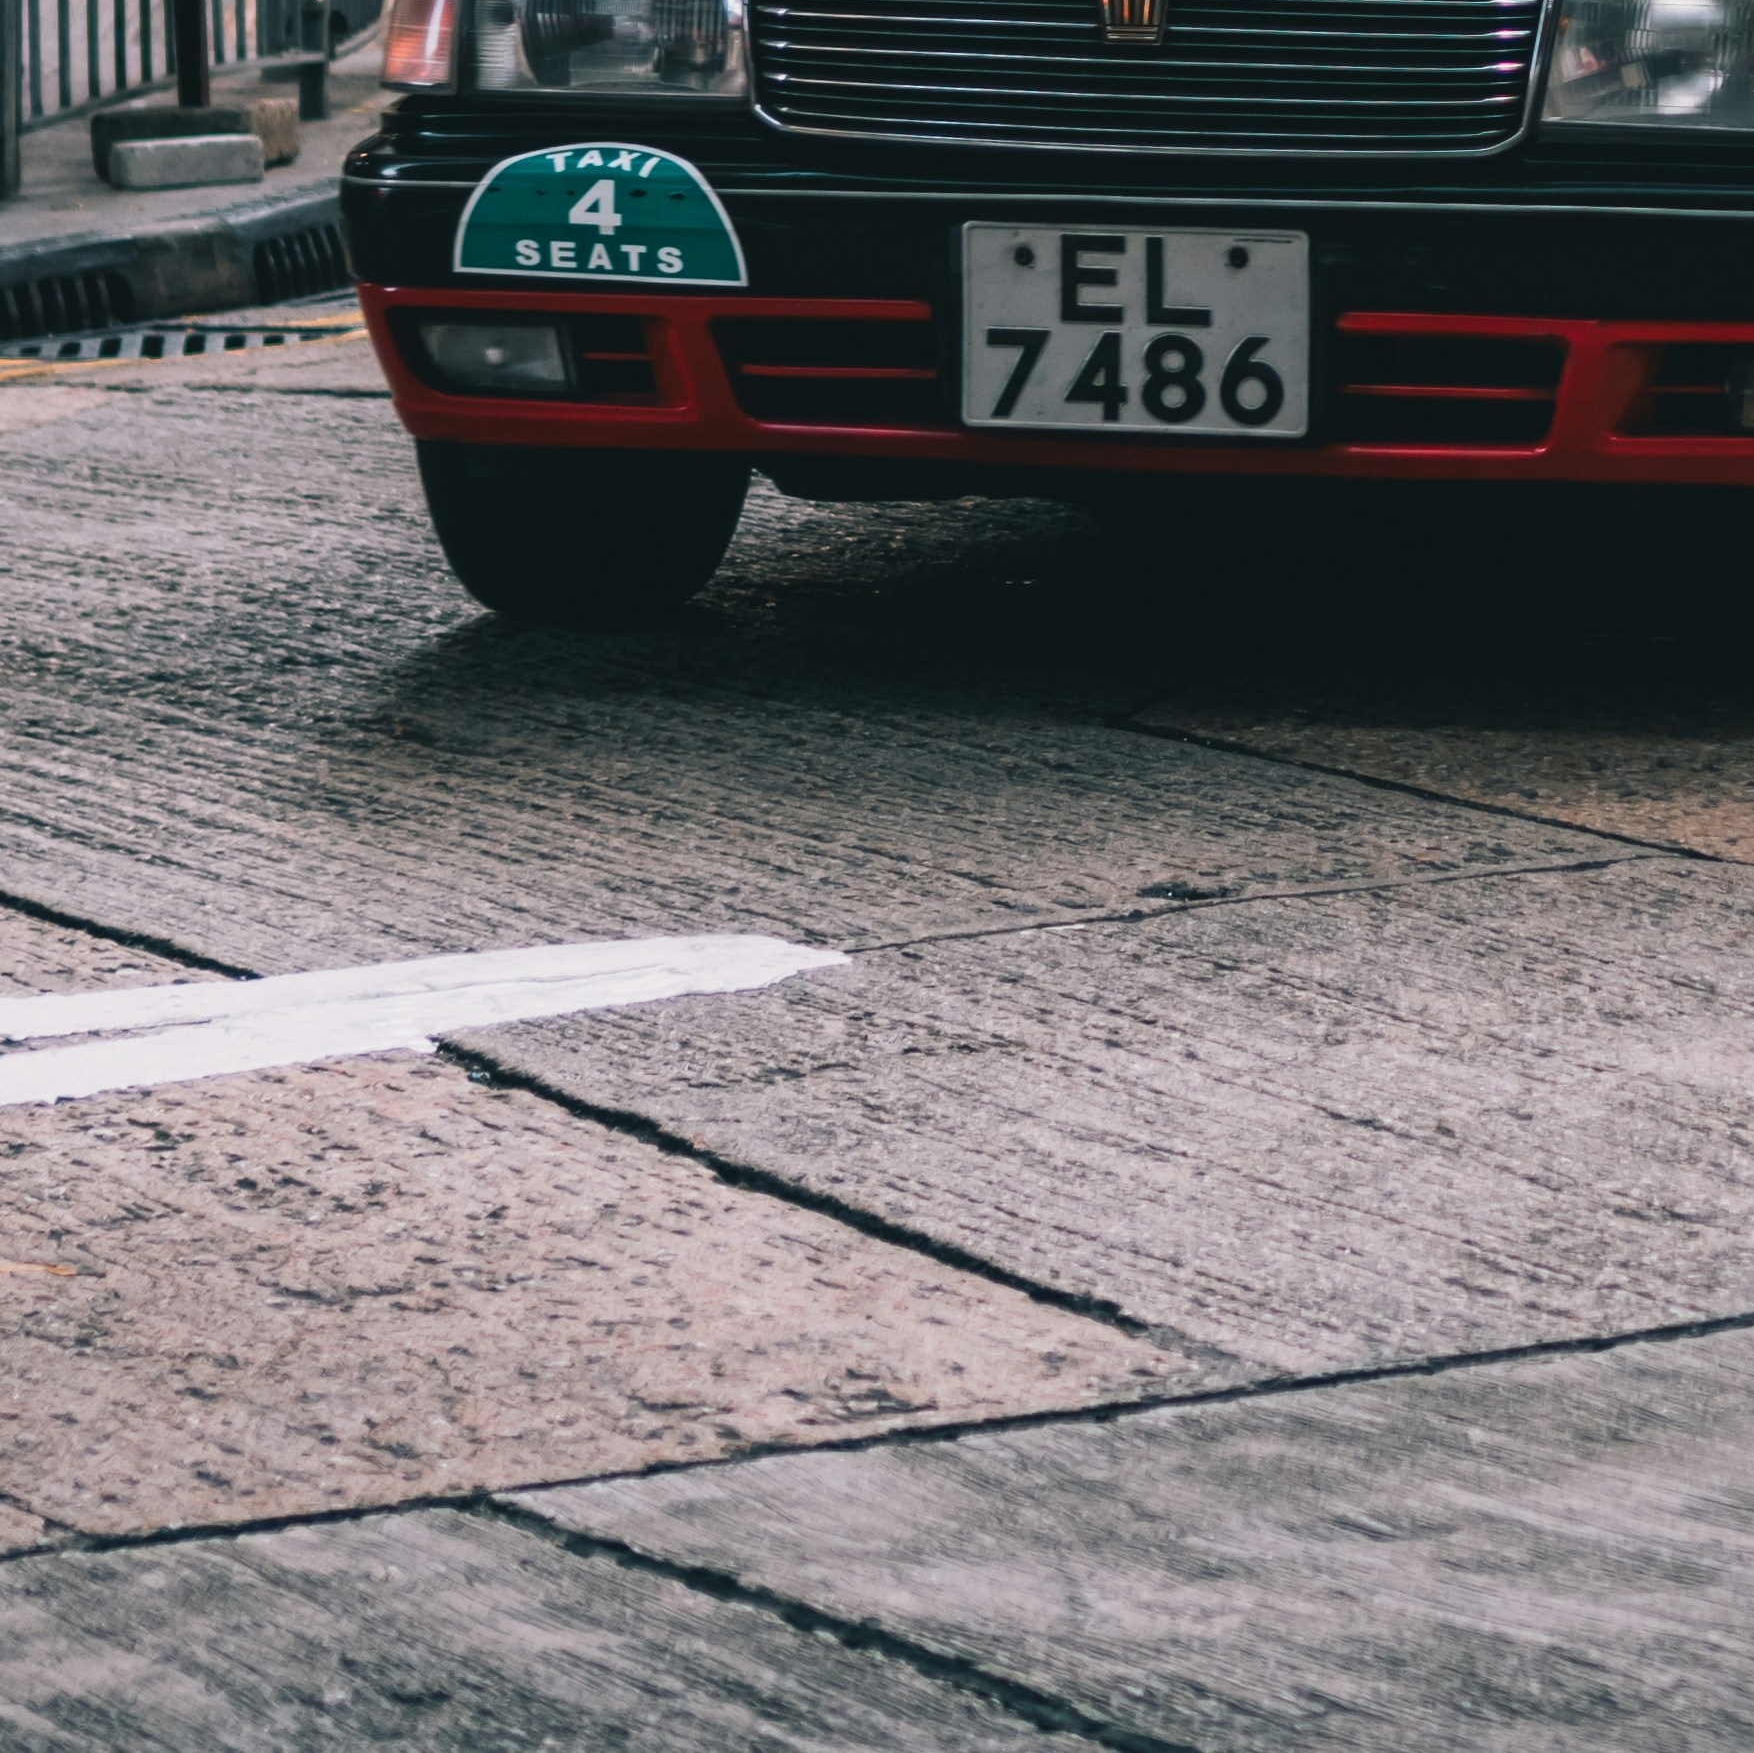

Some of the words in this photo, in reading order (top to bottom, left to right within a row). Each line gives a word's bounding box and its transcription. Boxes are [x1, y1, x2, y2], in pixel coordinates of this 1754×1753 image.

[545, 149, 662, 179] TAXI
[568, 178, 623, 236] 4
[514, 238, 684, 274] SEATS
[1060, 233, 1213, 328] EL
[984, 326, 1285, 427] 7486
